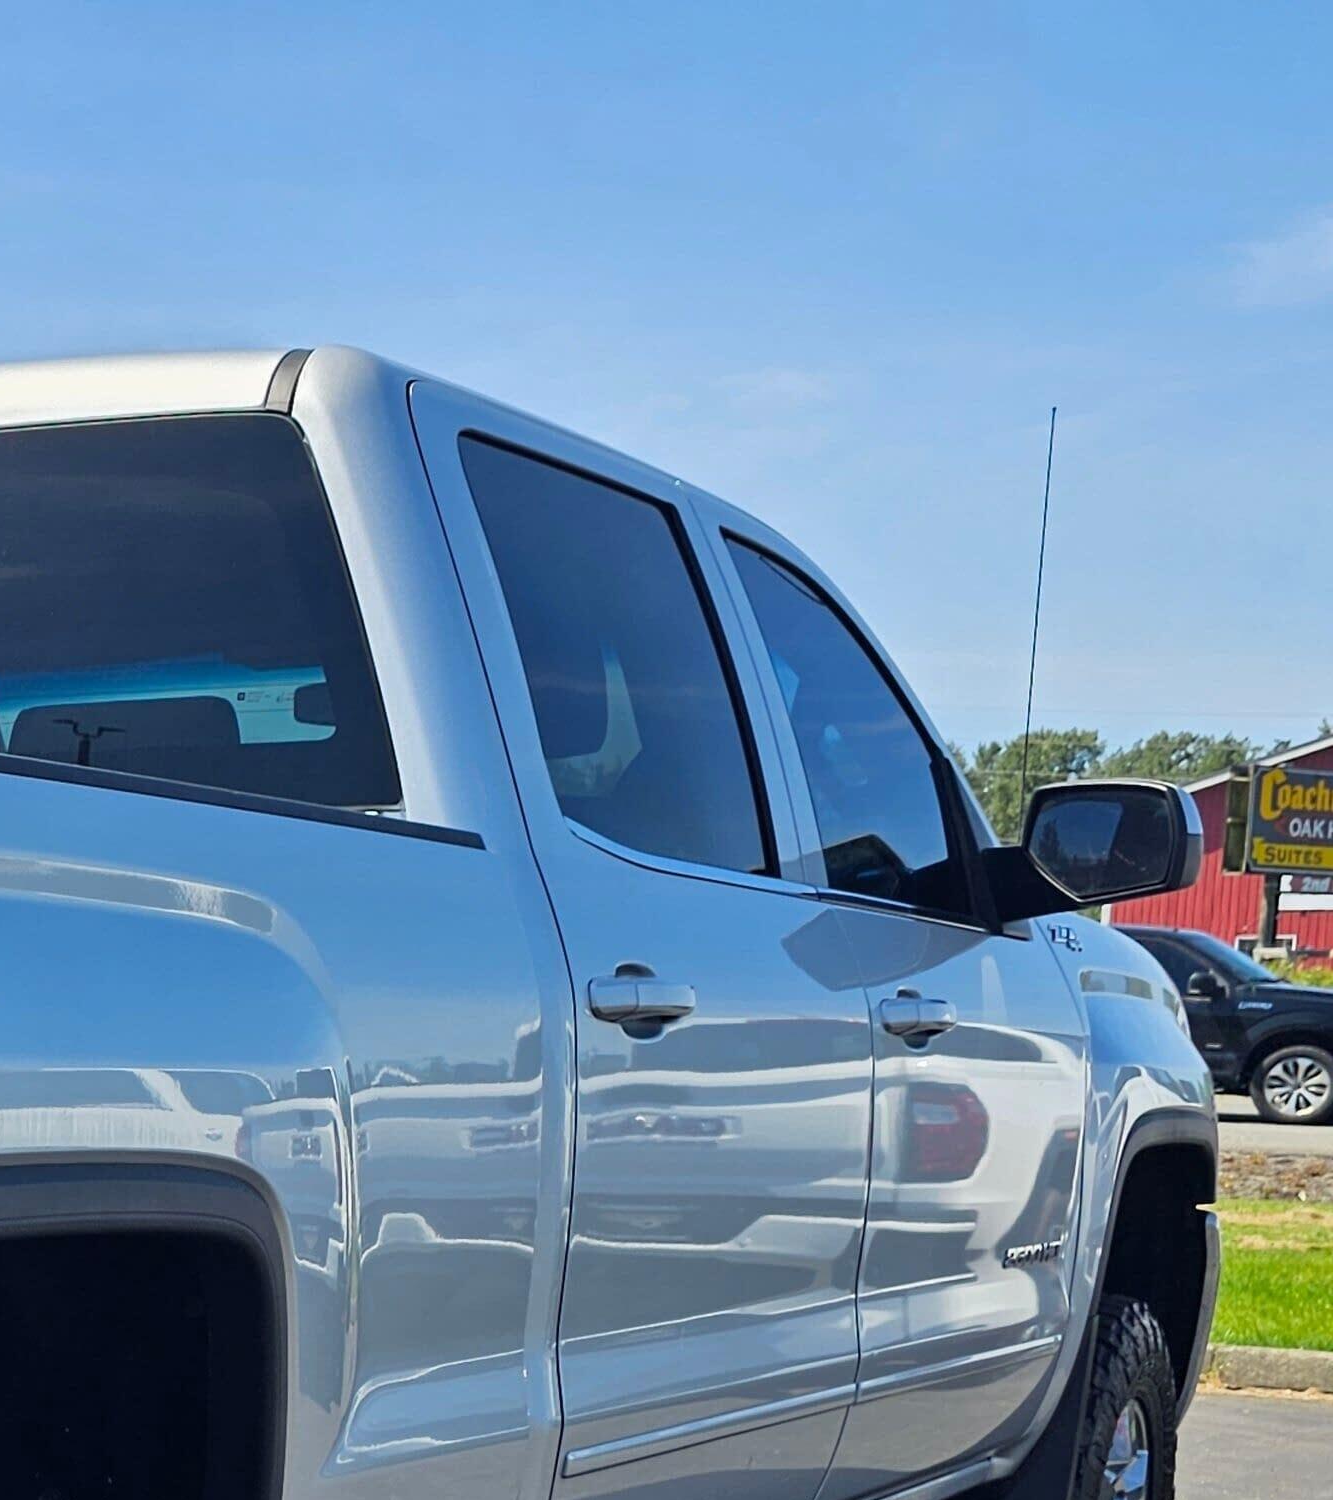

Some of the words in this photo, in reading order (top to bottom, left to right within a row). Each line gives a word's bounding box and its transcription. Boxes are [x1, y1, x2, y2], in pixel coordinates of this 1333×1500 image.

[1259, 768, 1333, 821] Coach
[1289, 817, 1325, 840] OAK
[1264, 846, 1323, 864] SUITES
